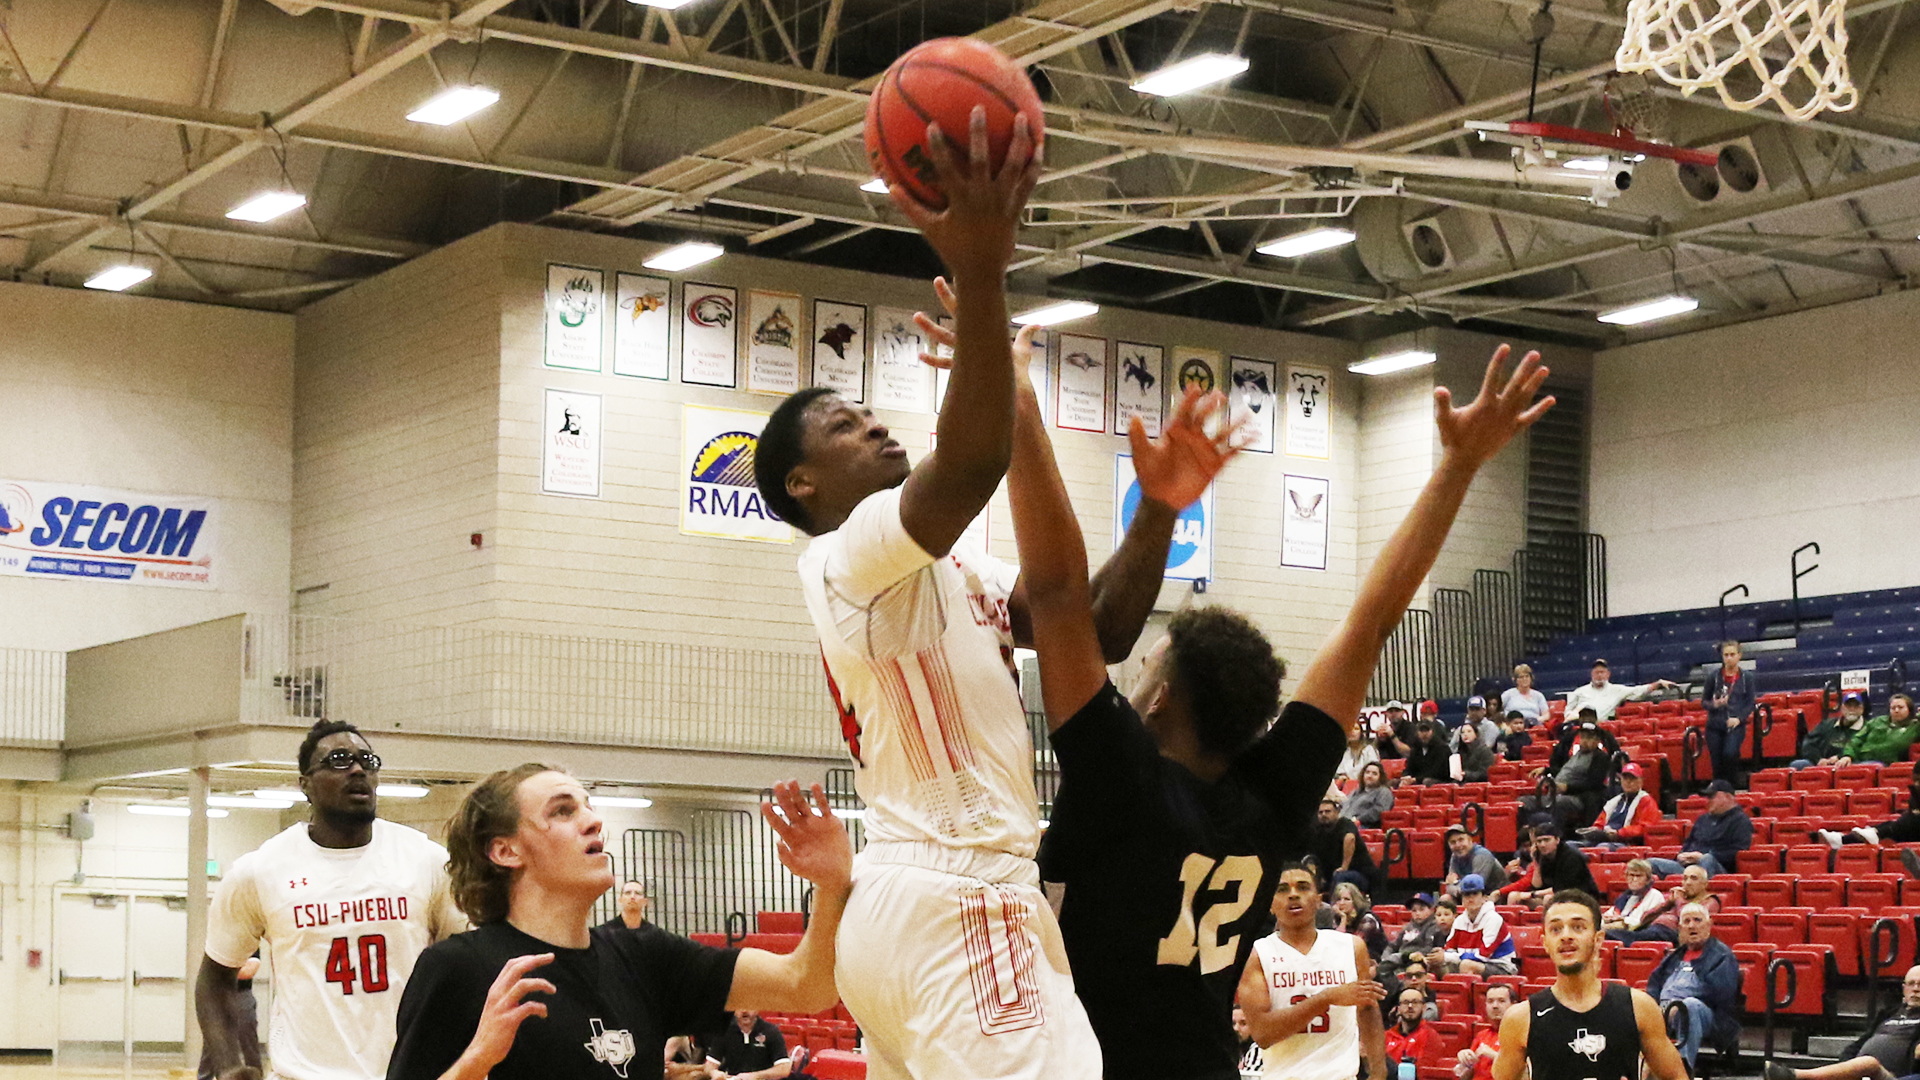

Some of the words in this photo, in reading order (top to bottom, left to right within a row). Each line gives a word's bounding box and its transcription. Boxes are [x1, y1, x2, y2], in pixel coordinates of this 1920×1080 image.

[554, 435, 591, 450] WSCU
[30, 497, 207, 557] SECOM
[1843, 676, 1867, 686] SECTION
[293, 897, 408, 929] CSU-PUEBLO
[1157, 852, 1263, 975] 12
[325, 934, 389, 995] 40
[1273, 970, 1346, 989] CSU-PUEBLO
